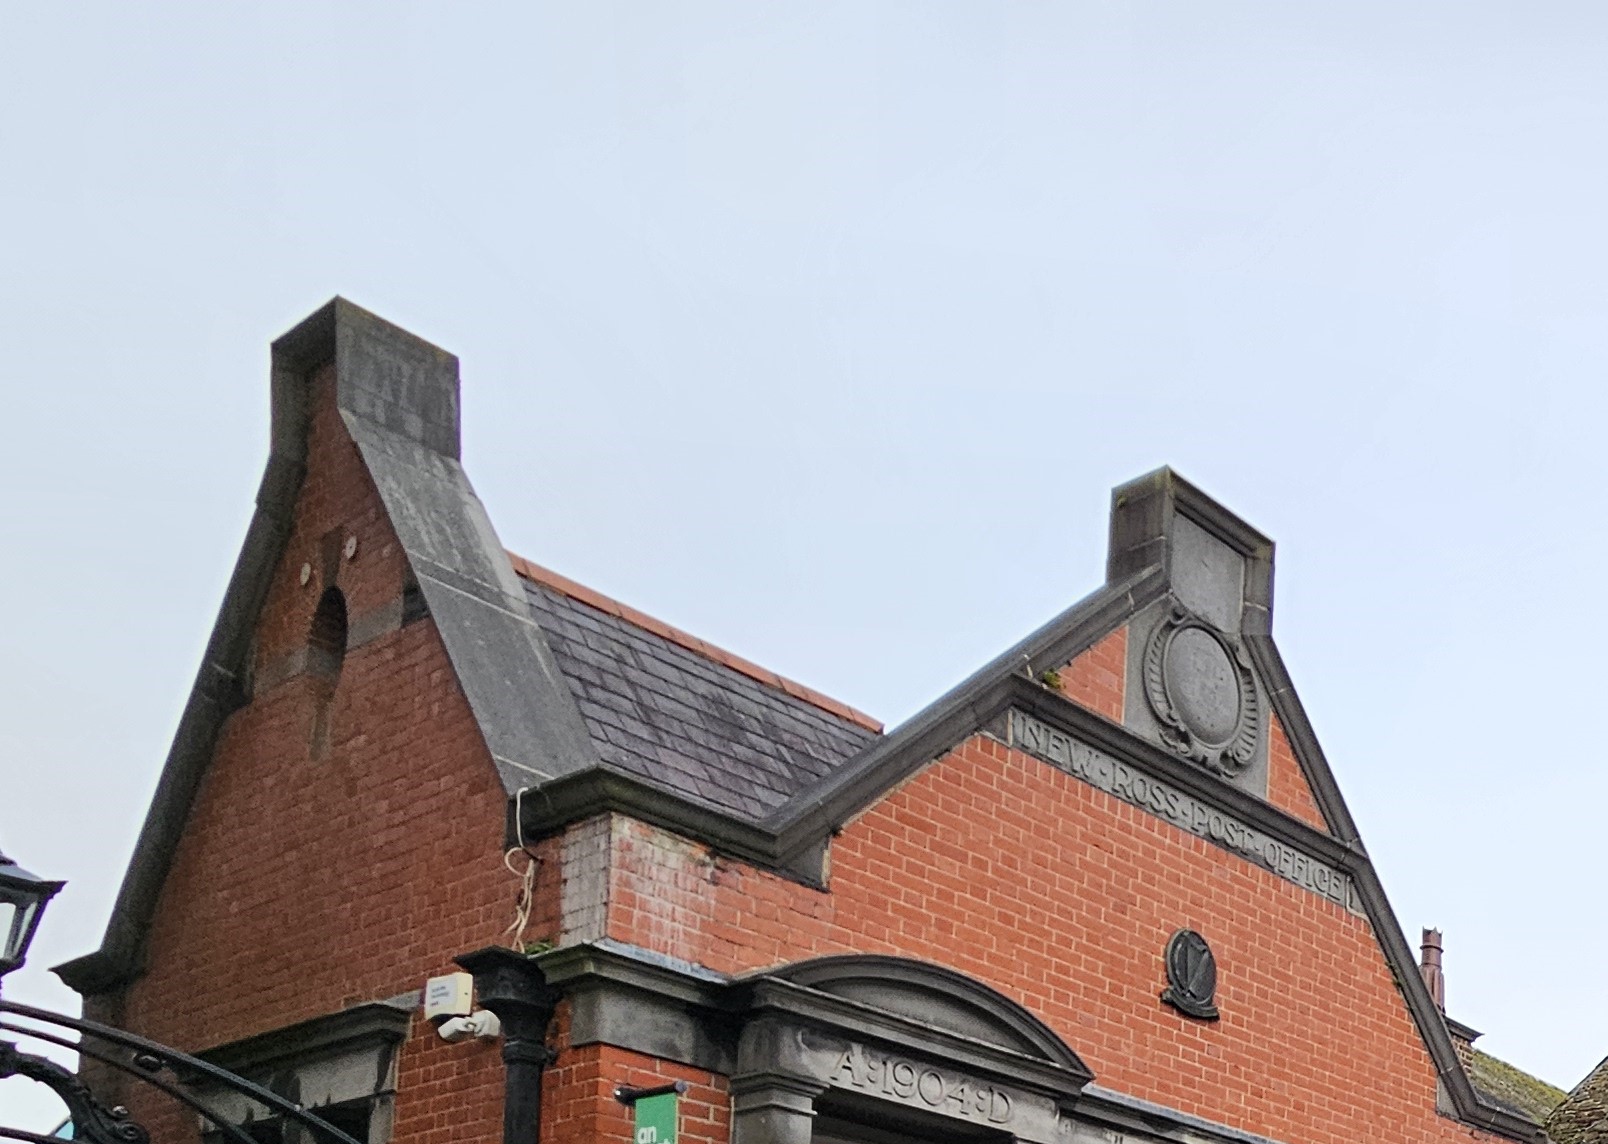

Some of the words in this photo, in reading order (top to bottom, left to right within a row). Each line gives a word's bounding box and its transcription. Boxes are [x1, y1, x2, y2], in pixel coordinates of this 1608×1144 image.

[1021, 720, 1093, 778] NEW
[1111, 765, 1181, 820] ROSS
[1190, 804, 1256, 856] POST
[1264, 841, 1343, 903] OFFICE
[637, 1126, 656, 1144] an
